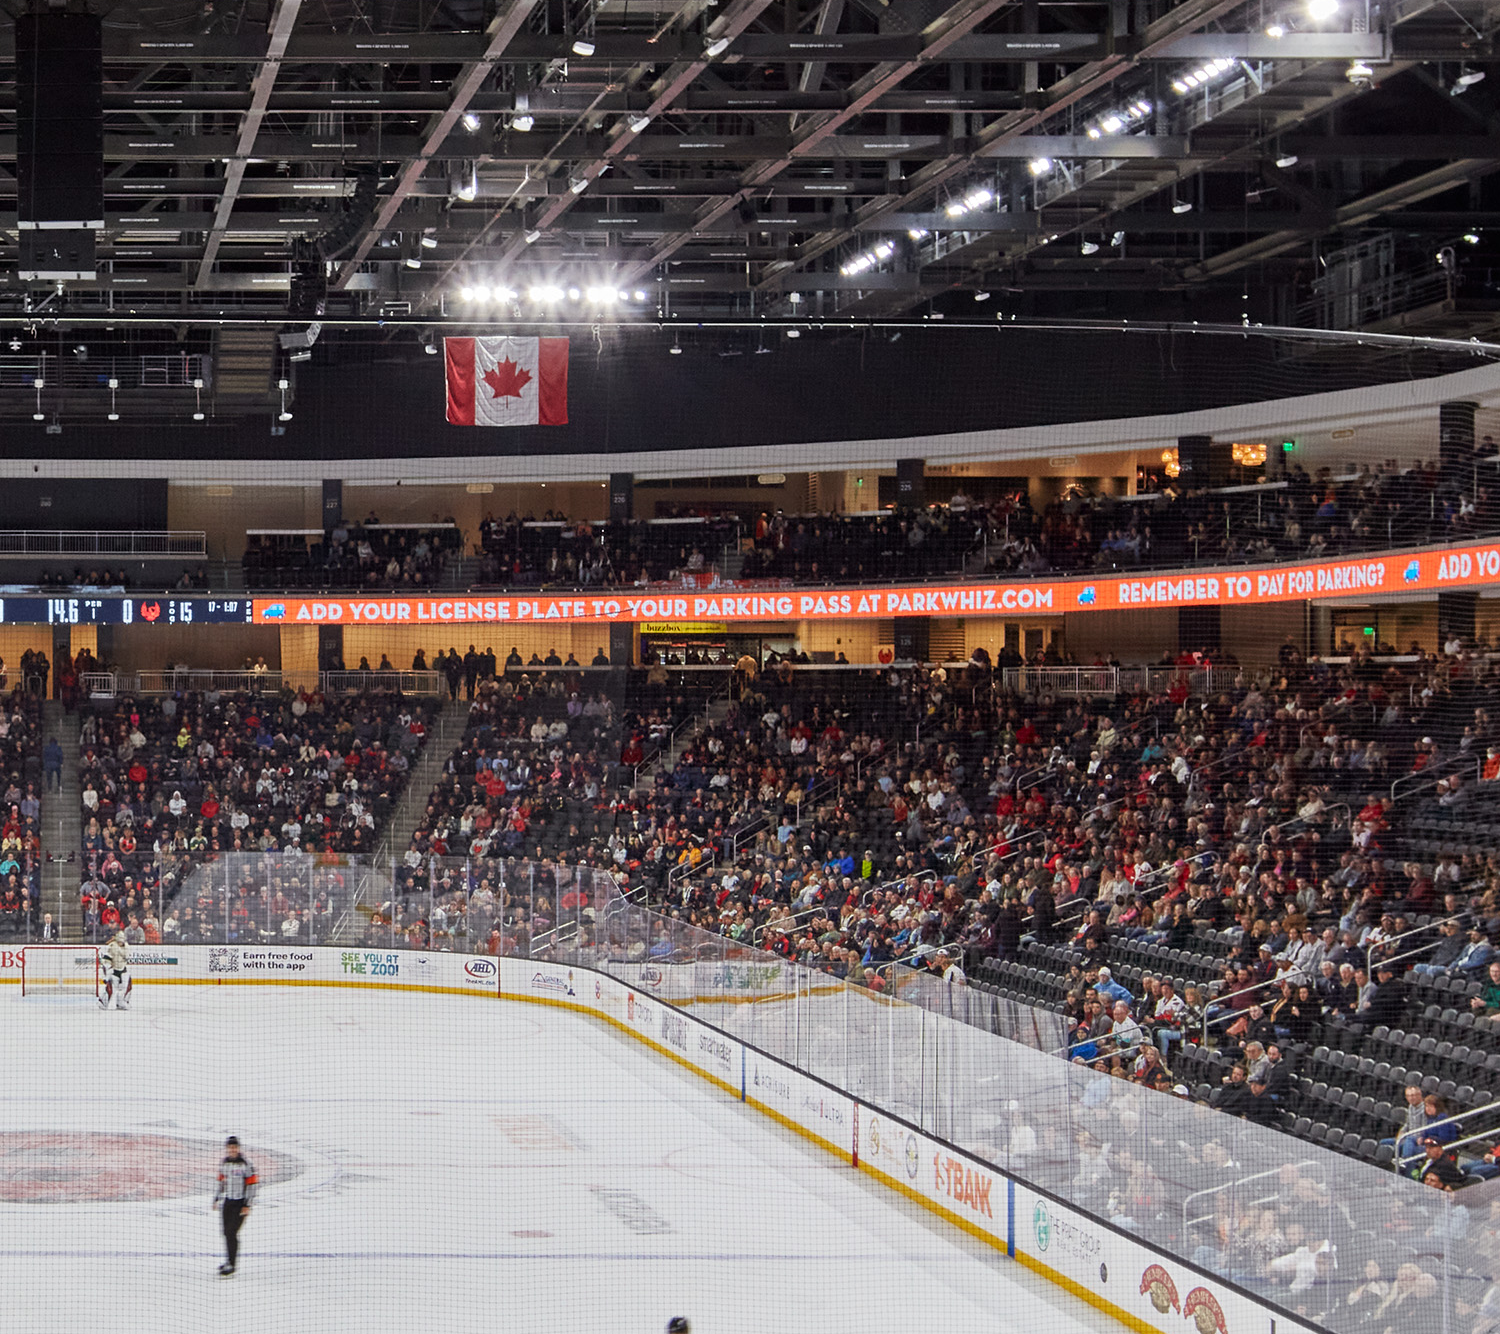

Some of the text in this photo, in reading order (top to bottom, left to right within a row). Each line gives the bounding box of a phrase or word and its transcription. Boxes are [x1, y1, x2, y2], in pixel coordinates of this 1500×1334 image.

[1438, 554, 1472, 579] ADD
[1120, 563, 1386, 603] REMEMBER TO PAY FOR PARKING?
[297, 589, 1053, 620] ADD YOUR LICENSE PLATE TO YOUR PARKING PASS AT PARKWHIZ.COM
[48, 599, 78, 623] 14.6
[123, 599, 133, 623] 0
[180, 602, 192, 622] 15
[646, 623, 681, 632] buzzbox
[243, 952, 313, 961] Earn free food
[341, 953, 399, 964] SEE YOU AT
[243, 961, 305, 971] with the app
[341, 962, 399, 976] THE ZOO!
[471, 963, 491, 974] AHL
